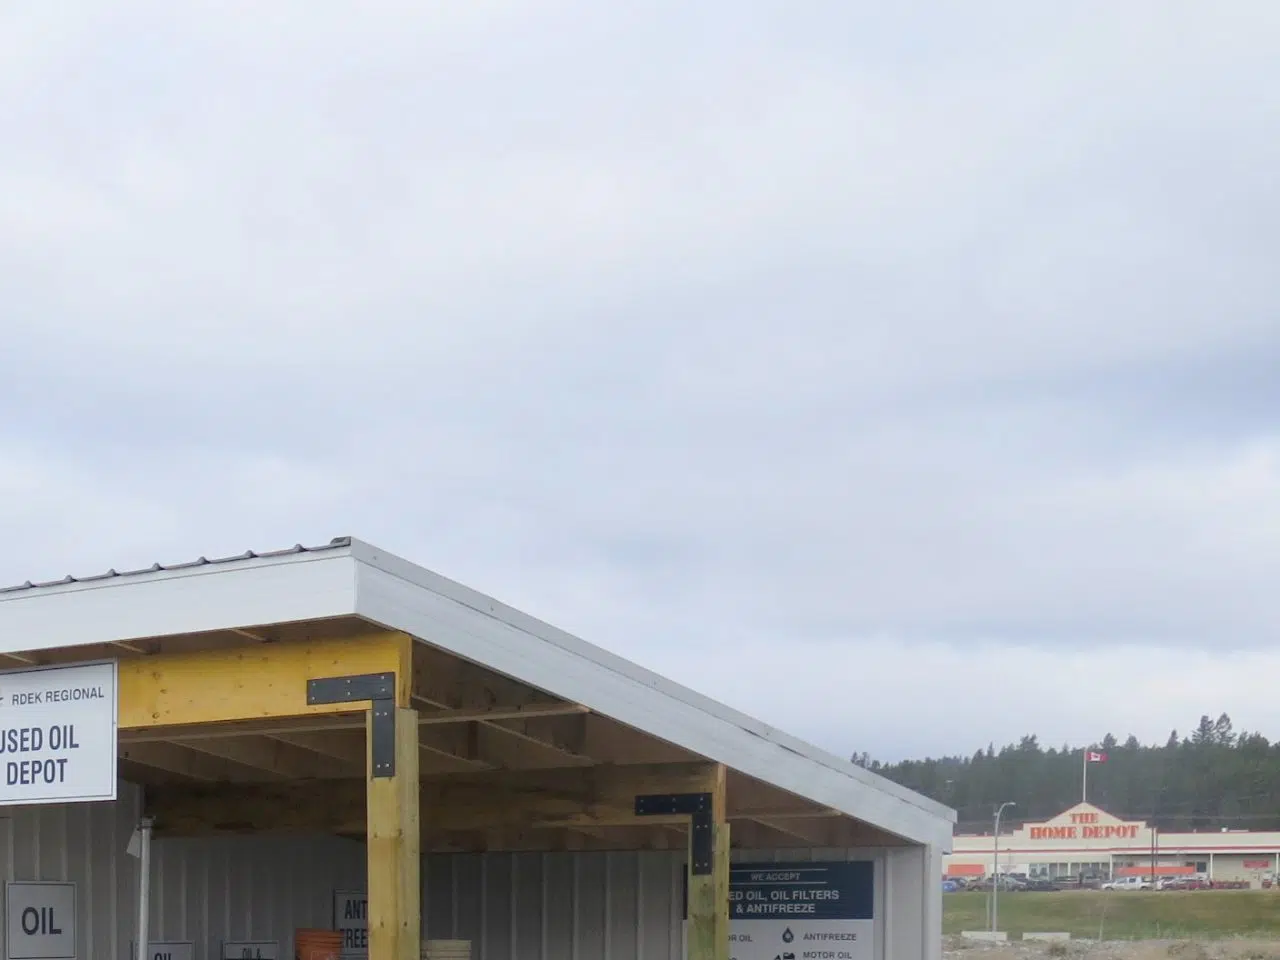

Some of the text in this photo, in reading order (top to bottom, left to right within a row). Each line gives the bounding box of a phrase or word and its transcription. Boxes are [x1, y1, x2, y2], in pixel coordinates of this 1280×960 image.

[12, 692, 42, 706] RDEK
[45, 686, 104, 703] REGIONAL
[49, 724, 79, 750] OIL
[6, 758, 68, 785] DEPOT
[1070, 813, 1098, 824] THE
[1030, 825, 1139, 840] HOME DEPOT
[728, 890, 840, 902] ED OIL, OIL FILTERS
[344, 899, 368, 919] ANT
[736, 904, 816, 913] & ANTIFREEZE
[21, 906, 63, 935] OIL
[803, 933, 857, 941] ANTIFREEZE
[803, 951, 852, 959] MOTOR OIL
